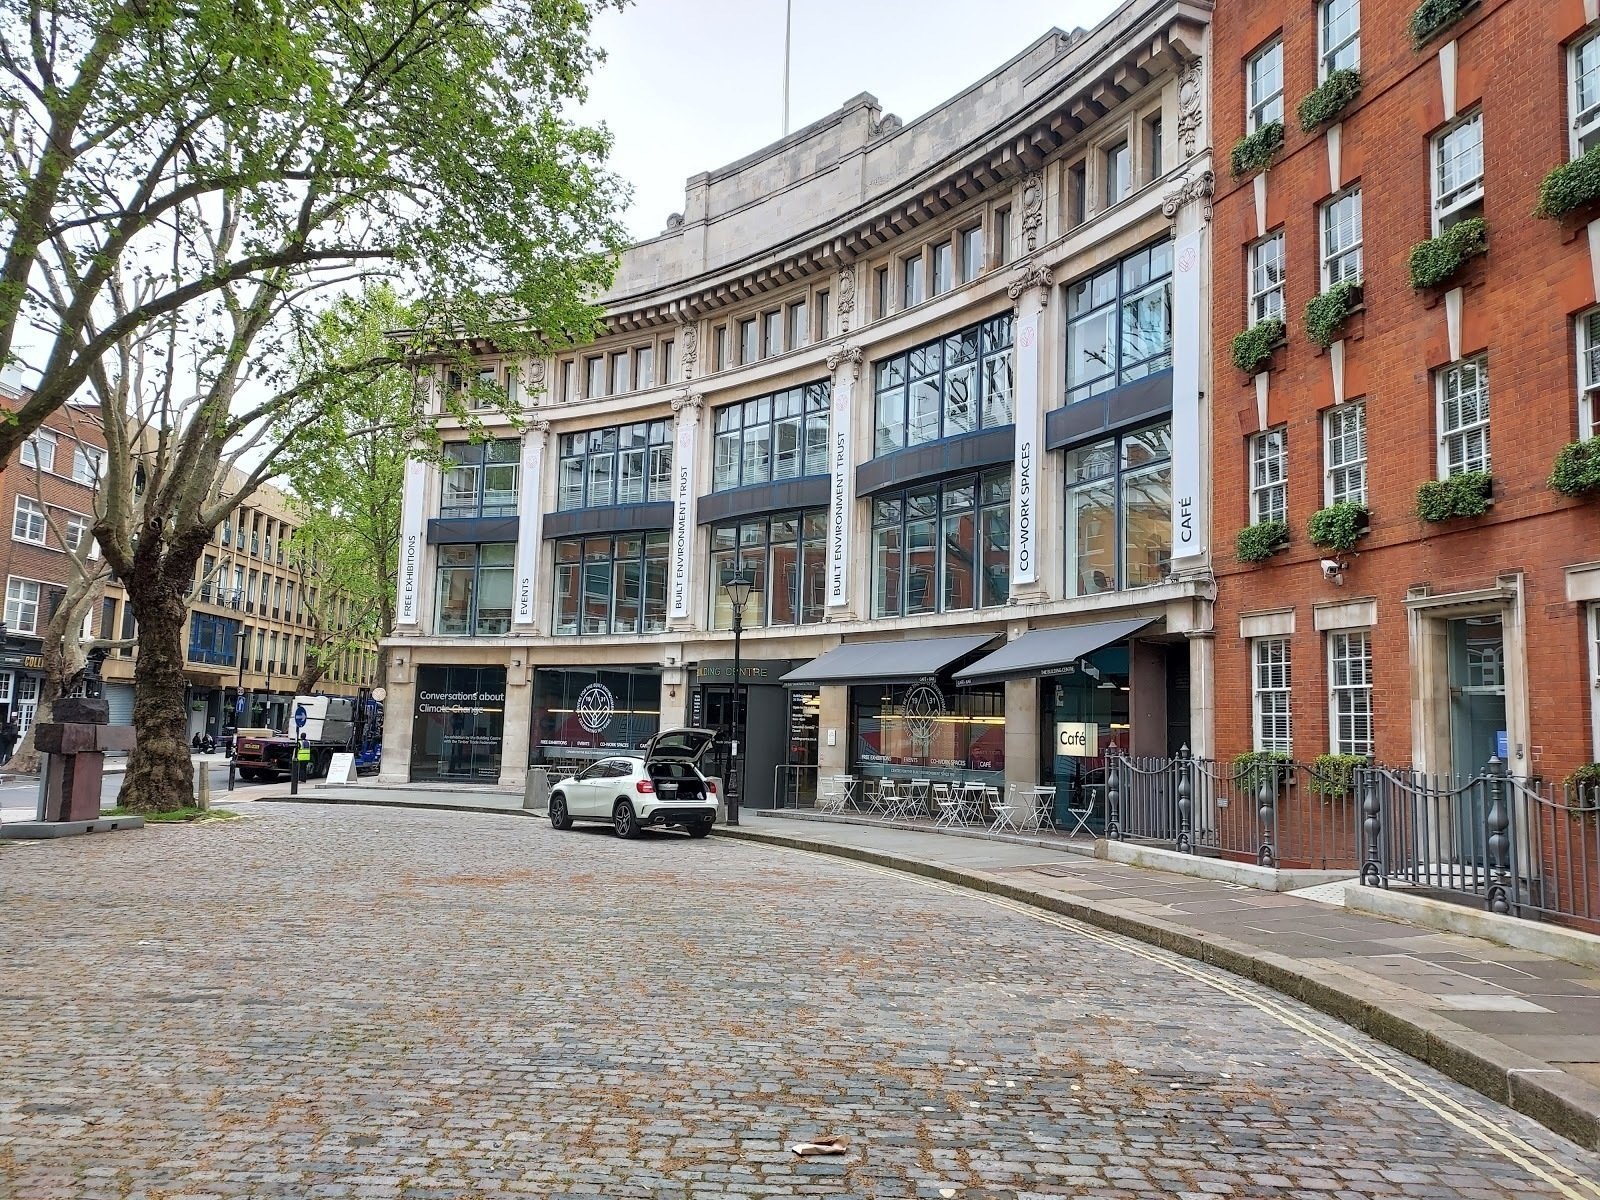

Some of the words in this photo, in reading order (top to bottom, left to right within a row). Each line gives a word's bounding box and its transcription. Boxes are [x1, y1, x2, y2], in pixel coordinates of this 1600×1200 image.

[836, 431, 845, 470] TRUST
[1021, 441, 1031, 496] SPACES
[679, 466, 689, 499] TRUST
[834, 472, 844, 561] ENVIRONMENT
[1019, 497, 1030, 572] CO-WORK
[1178, 496, 1192, 543] CAFÉ
[676, 500, 687, 580] ENVIRONMENT
[406, 535, 416, 592] EXHIBITIONS
[833, 565, 842, 596] BUILT
[404, 594, 412, 617] FREE
[520, 577, 529, 616] EVENTS
[675, 582, 683, 609] BUILT
[419, 703, 450, 713] Climate
[452, 704, 484, 716] Change
[420, 691, 478, 701] Conversations
[479, 691, 505, 701] about
[1060, 731, 1086, 746] Café
[979, 760, 992, 768] CAFÉ
